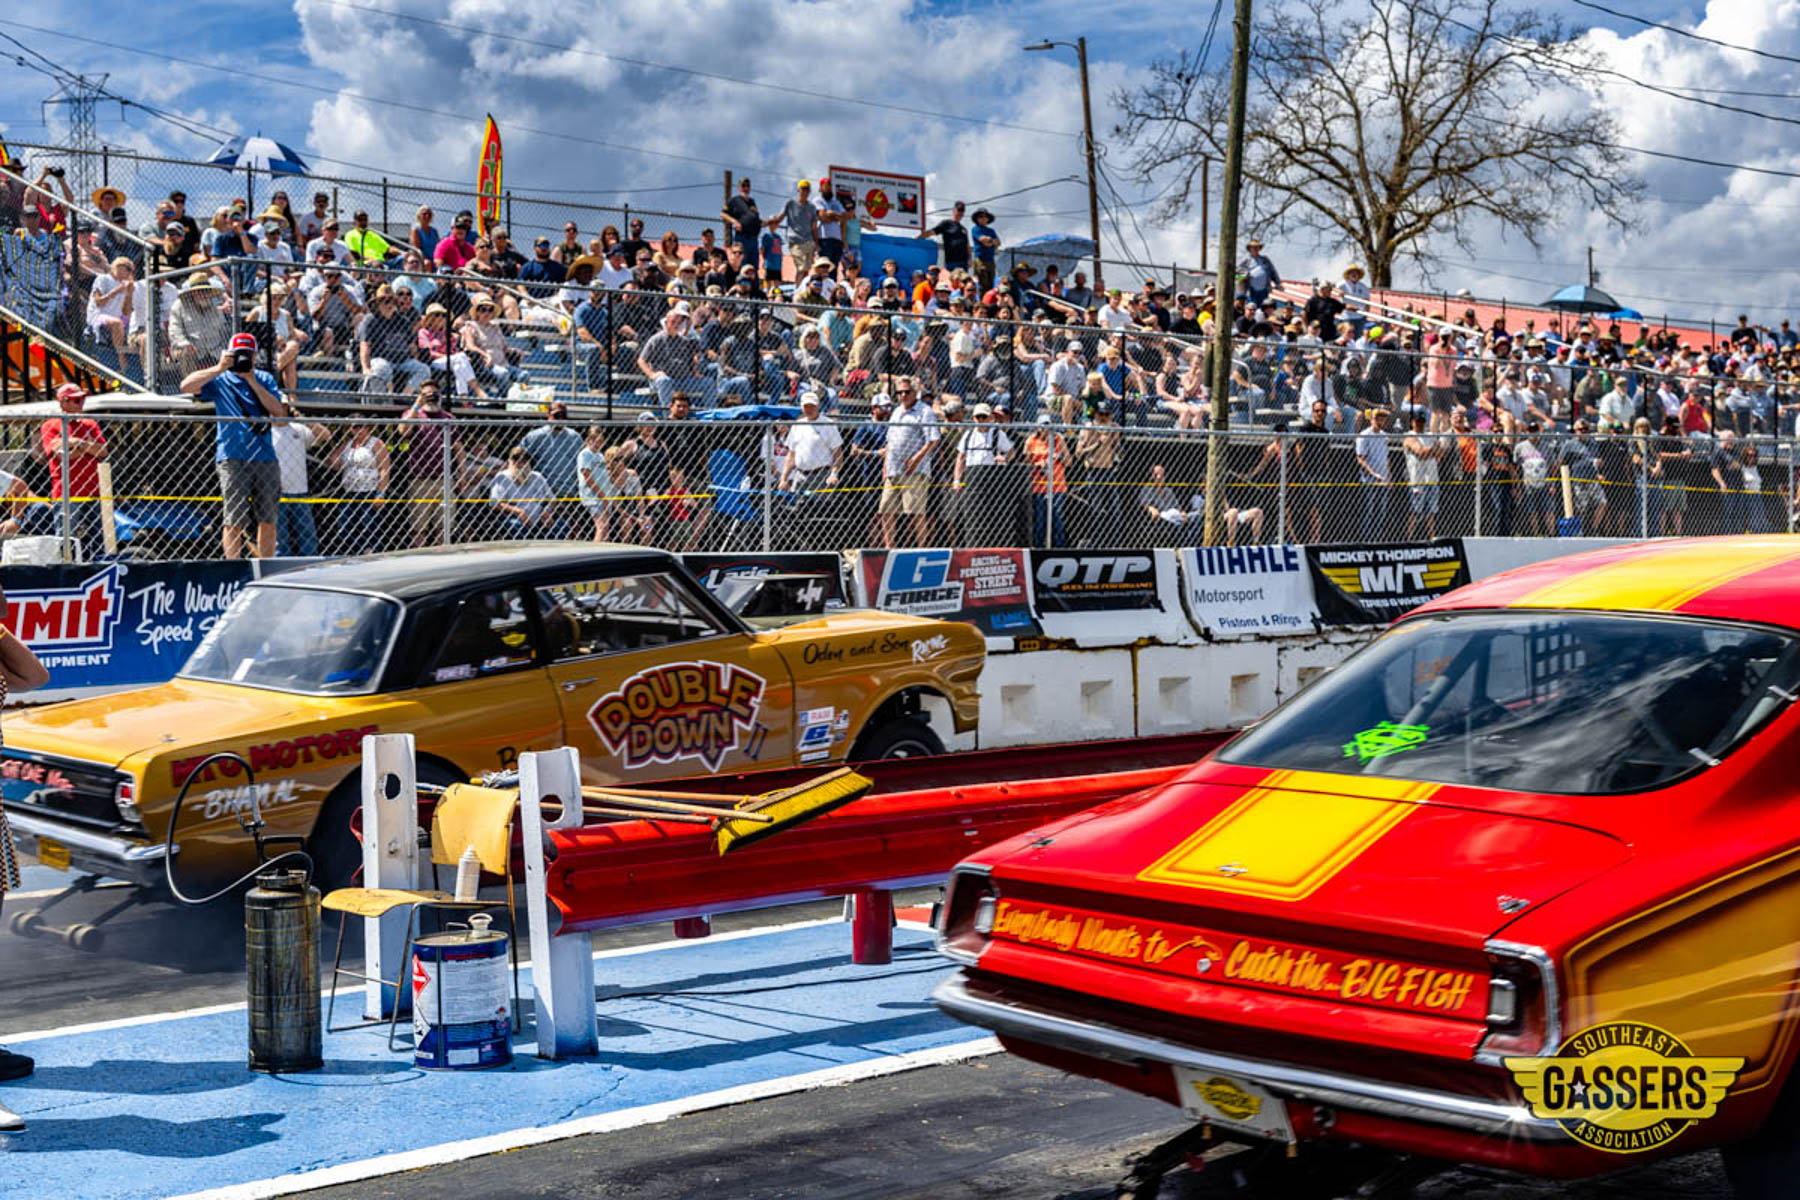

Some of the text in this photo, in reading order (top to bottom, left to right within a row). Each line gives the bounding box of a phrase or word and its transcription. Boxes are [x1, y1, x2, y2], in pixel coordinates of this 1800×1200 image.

[1196, 546, 1300, 575] MAHLE
[1320, 546, 1454, 563] MICKEY THOMPSON
[960, 563, 1017, 577] PERFORMANCE
[975, 574, 1015, 588] STREET
[1036, 556, 1152, 588] QTP
[1359, 562, 1428, 594] M/T
[127, 581, 175, 621] The
[883, 587, 961, 606] FORCE
[1194, 588, 1264, 604] Motorsport
[136, 616, 193, 655] Speed
[1218, 616, 1259, 628] Pistons
[1271, 613, 1301, 628] Rings
[850, 638, 876, 657] and
[596, 667, 758, 742] DOUBLE
[630, 709, 731, 761] DOWN
[992, 902, 1081, 951] Everybody
[1077, 917, 1142, 958] Wants
[1224, 940, 1293, 985] Catch
[1340, 958, 1401, 1000] BIG
[1396, 967, 1475, 1010] FISH
